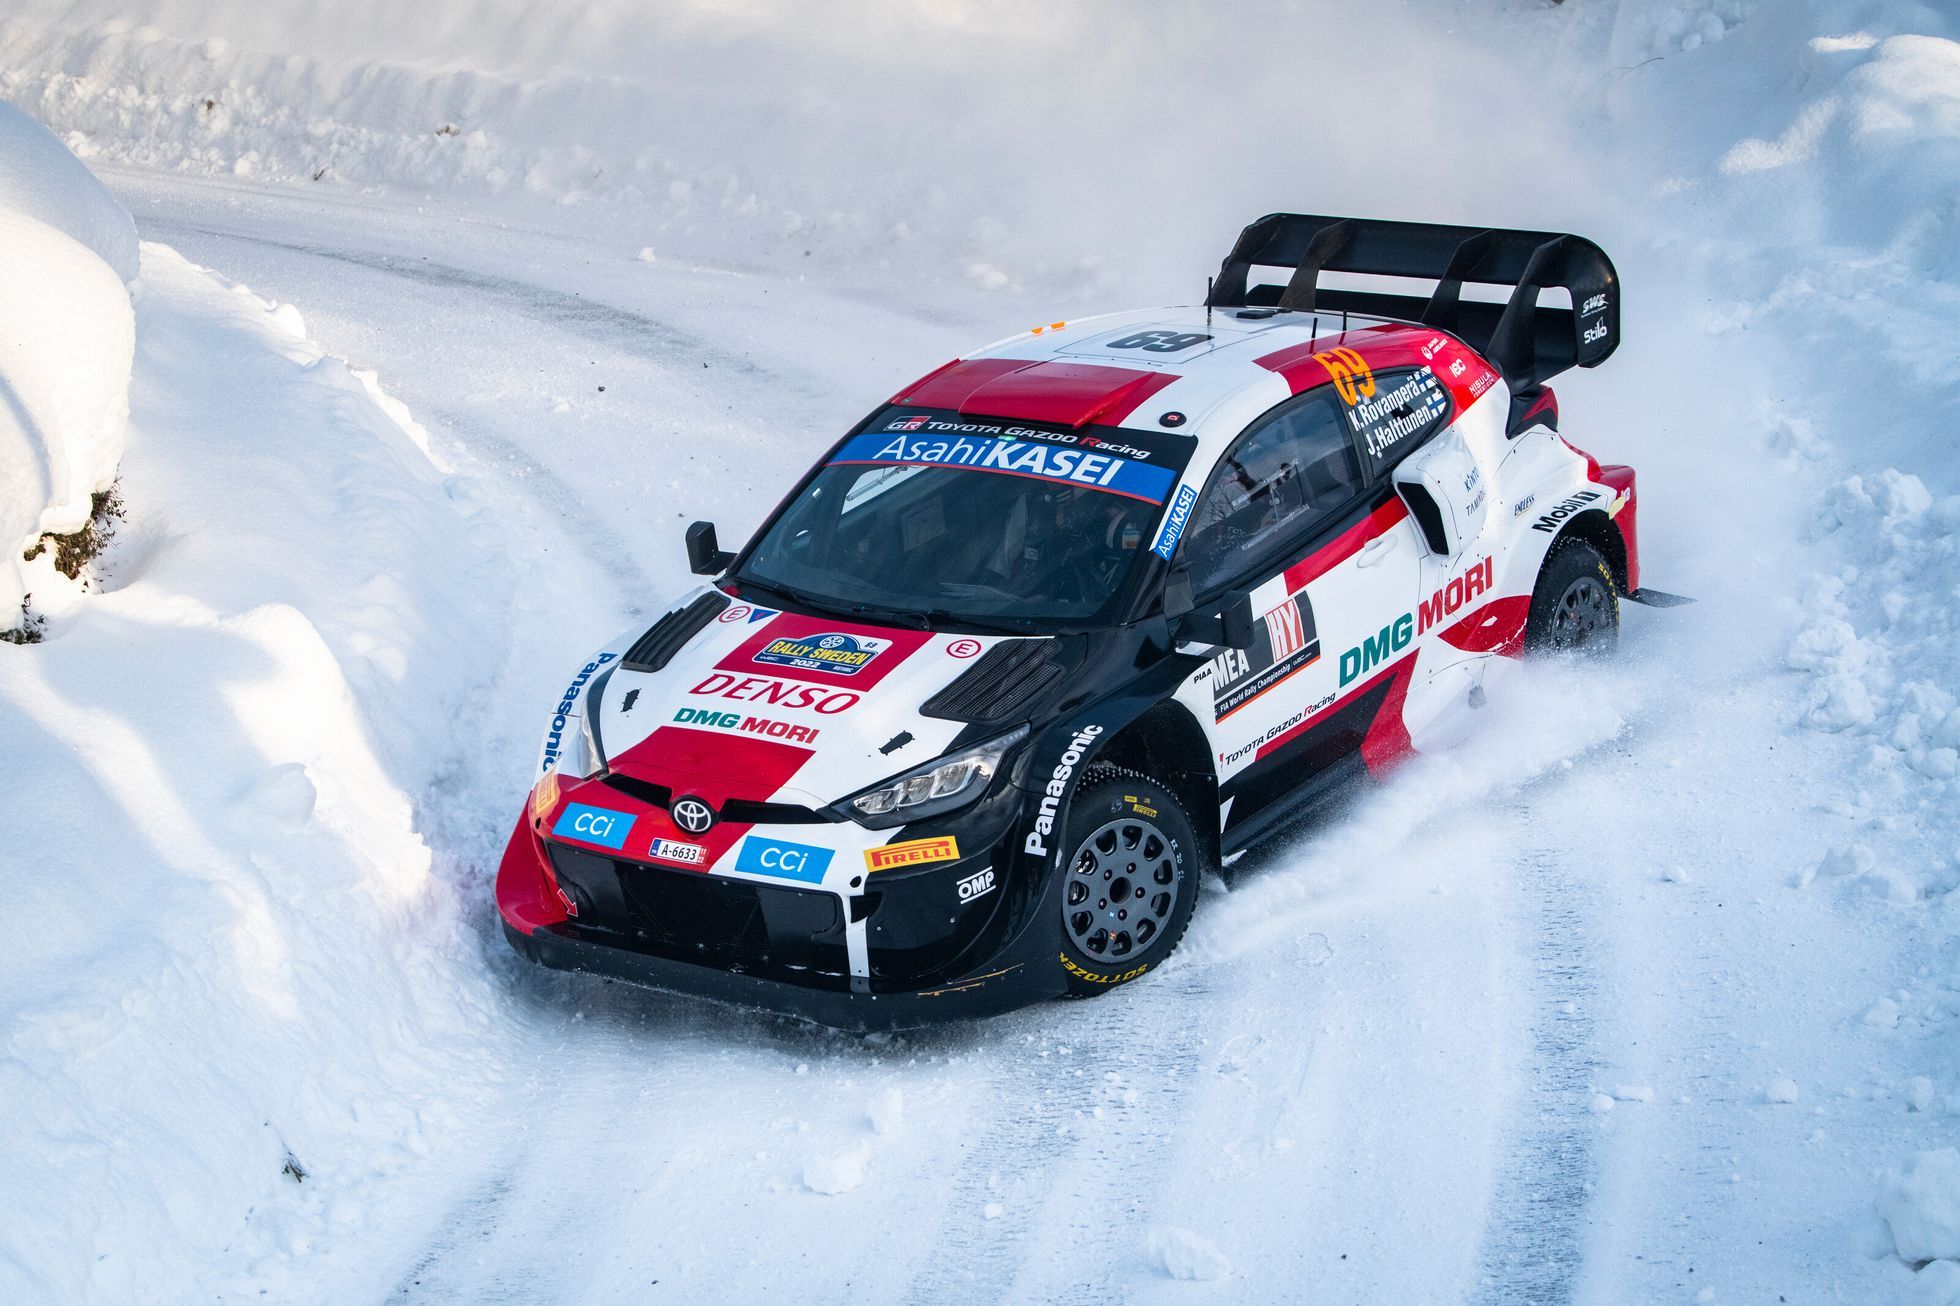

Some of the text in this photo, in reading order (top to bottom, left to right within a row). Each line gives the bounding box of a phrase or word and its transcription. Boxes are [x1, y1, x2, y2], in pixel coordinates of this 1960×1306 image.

[1106, 331, 1215, 352] 69
[1584, 317, 1607, 344] Stilo
[1312, 347, 1376, 406] 69
[887, 420, 1151, 460] GR TOYOTA GAZOO Racing
[1531, 499, 1587, 533] Mobil
[1339, 555, 1493, 689] DMG MORI
[768, 641, 873, 665] RALLY SWEDEN
[790, 658, 821, 668] 2022
[1194, 668, 1212, 684] PIAA
[1220, 703, 1229, 713] FIA
[1229, 692, 1244, 707] World
[1244, 684, 1258, 697] Rally
[1257, 663, 1291, 689] Championship
[688, 673, 861, 715] DENSO
[542, 652, 619, 772] Panasonic
[673, 707, 820, 744] DMG MORI
[1225, 692, 1336, 766] TOYOTA GAZOO Racing
[1024, 724, 1104, 857] Panasonic
[661, 844, 697, 860] A-6633
[871, 841, 950, 867] PIRELLI
[958, 871, 995, 898] OMP
